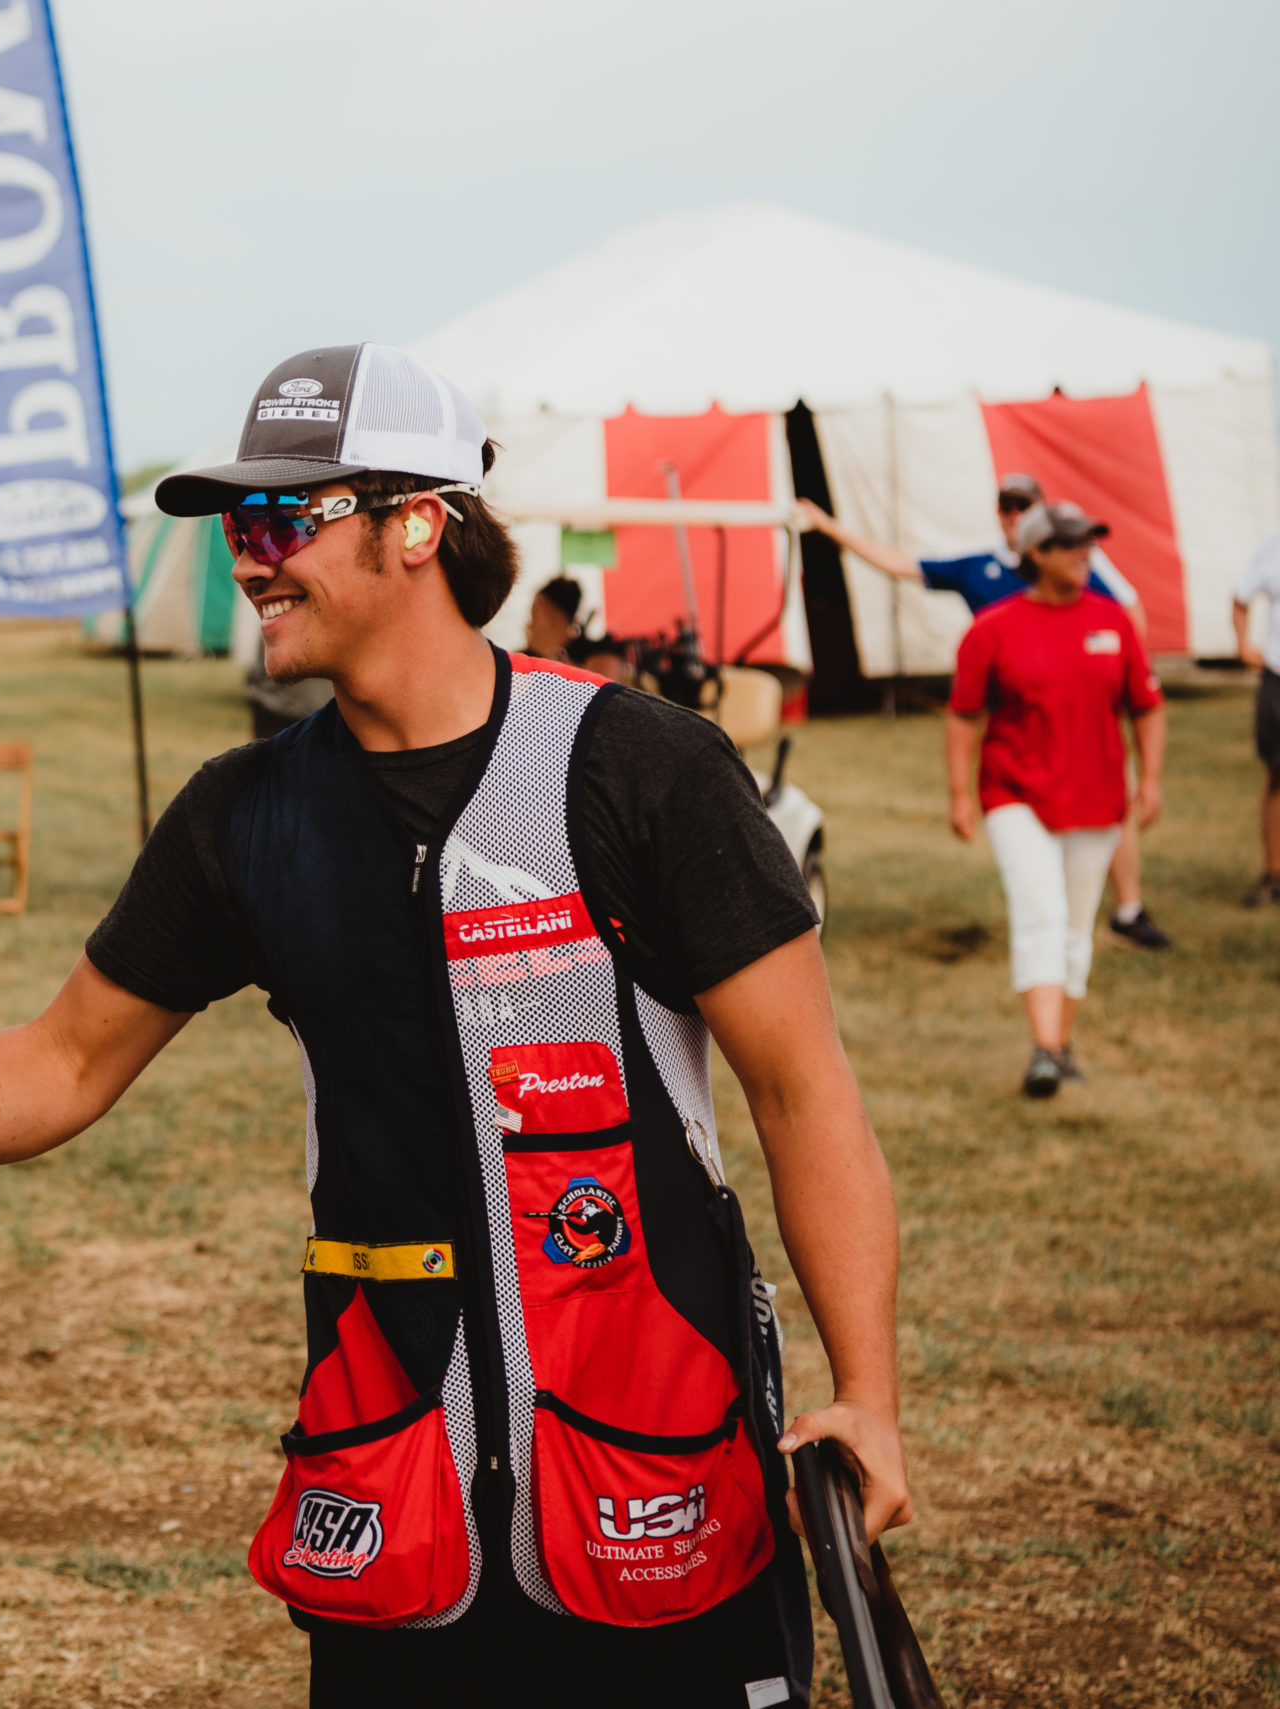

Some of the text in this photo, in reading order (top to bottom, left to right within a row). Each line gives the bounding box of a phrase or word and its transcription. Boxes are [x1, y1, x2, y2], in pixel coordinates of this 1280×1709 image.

[258, 397, 340, 409] POWER STROKE
[260, 409, 336, 419] DIESEL
[458, 909, 573, 943] CASTELLANI
[490, 1064, 516, 1077] TRUMP
[518, 1071, 605, 1099] Preston
[558, 1187, 617, 1212] SCHOLASTIC
[554, 1232, 576, 1257] CLAY
[607, 1216, 624, 1254] TARGET
[284, 1539, 370, 1575] Shooting
[586, 1540, 665, 1560] ULTIMATE
